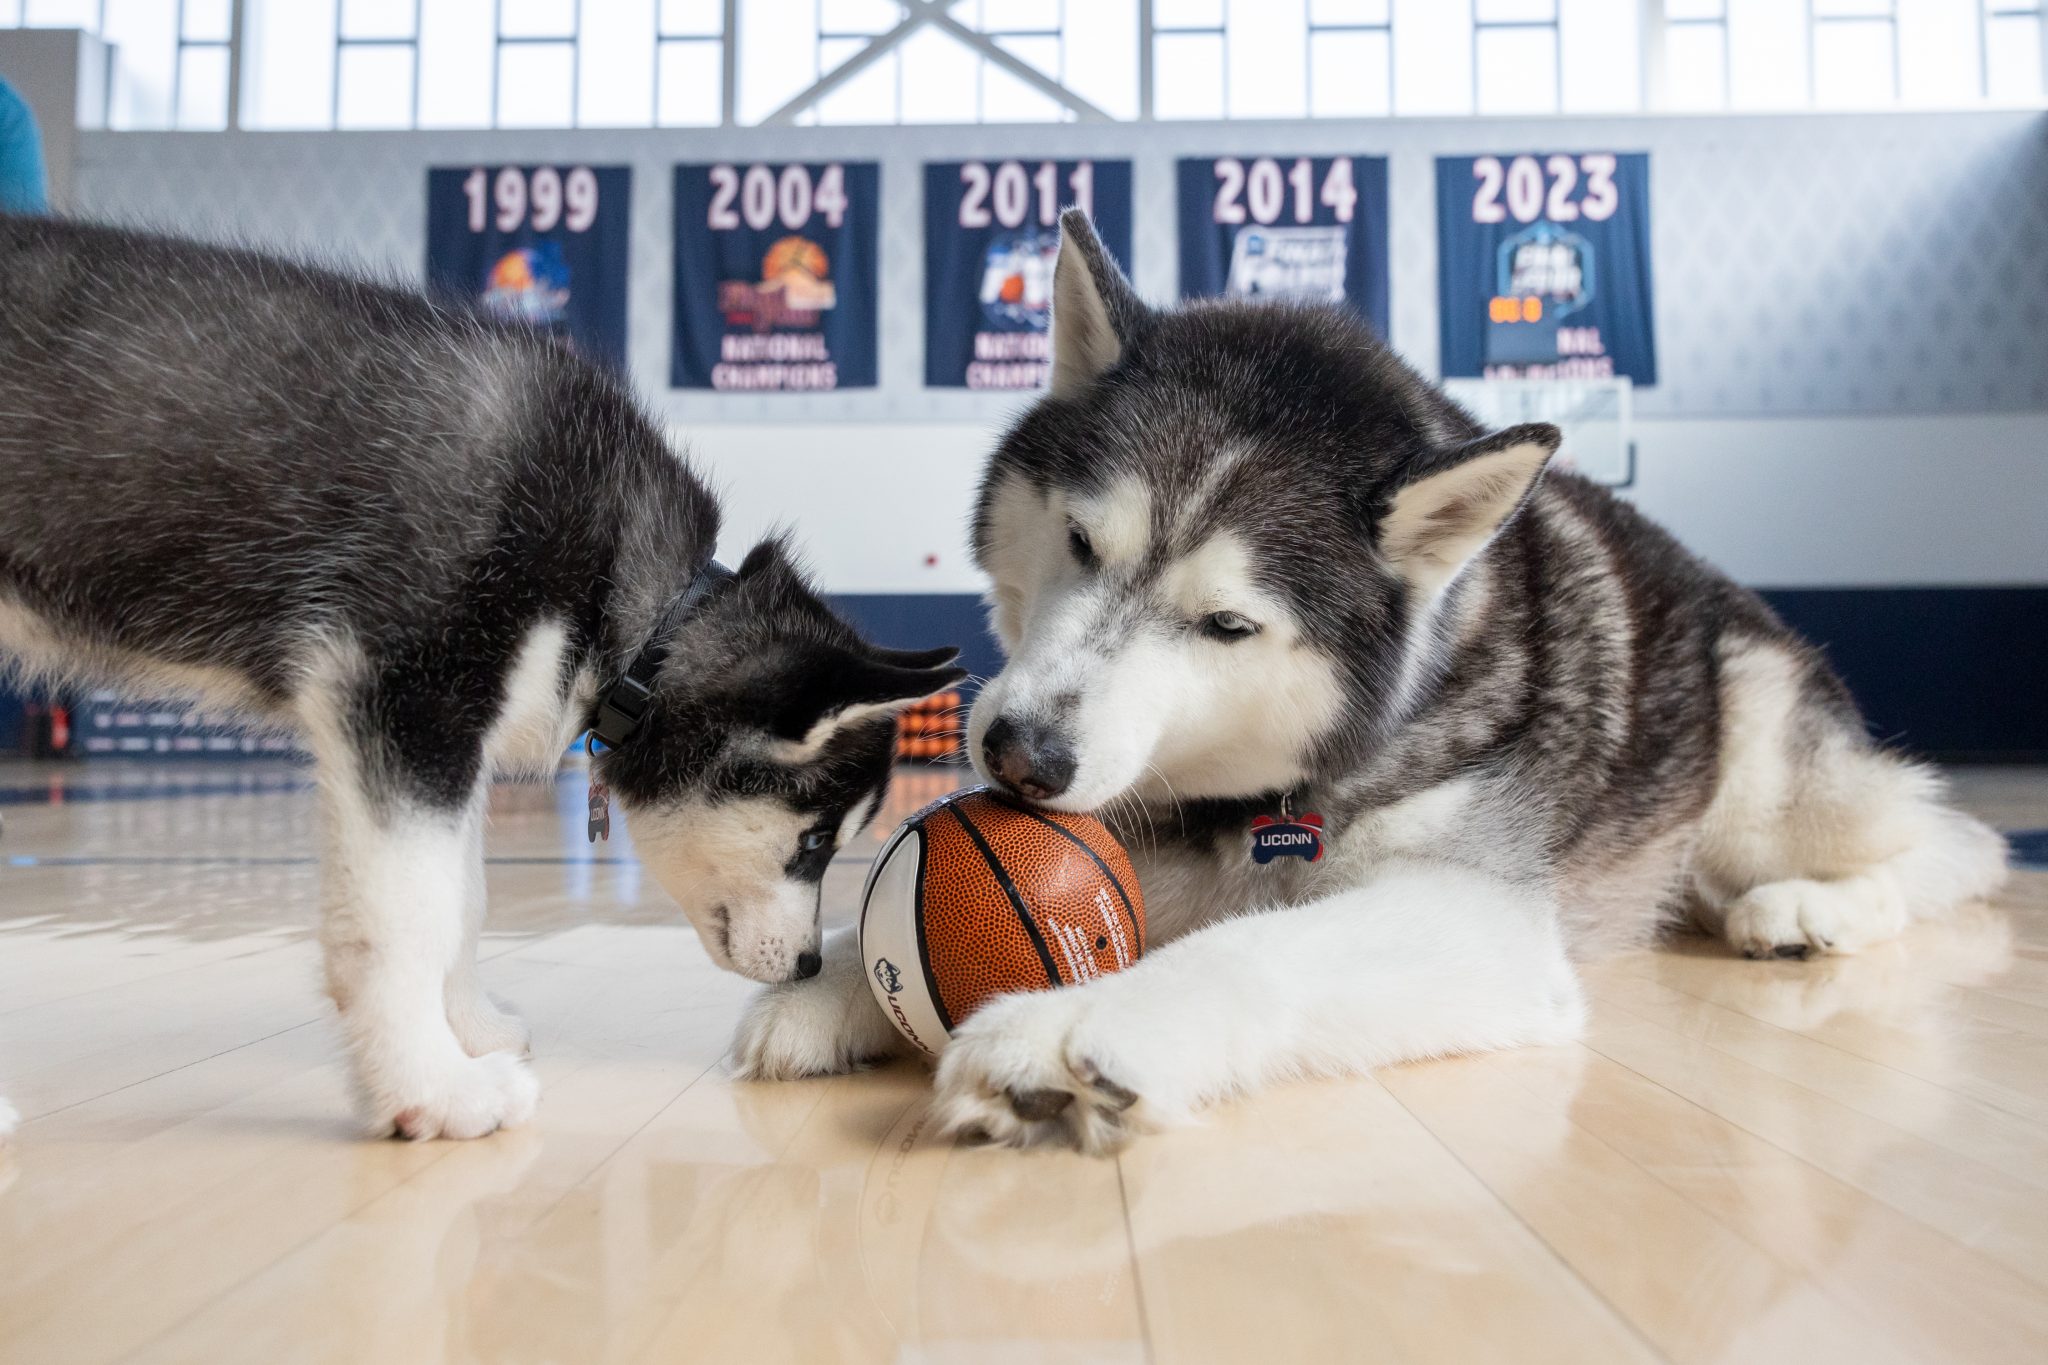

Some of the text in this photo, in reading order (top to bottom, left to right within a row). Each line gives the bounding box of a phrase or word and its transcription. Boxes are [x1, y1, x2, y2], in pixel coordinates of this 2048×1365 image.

[464, 165, 599, 233] 1999
[708, 163, 847, 231] 2004
[958, 159, 1095, 229] 2011
[1213, 156, 1358, 225] 2014
[1471, 153, 1619, 224] 2023
[711, 361, 838, 391] CHAMPIONS
[721, 333, 830, 361] NATIONAL
[1261, 832, 1312, 847] UCONN
[1064, 924, 1079, 952] CHINA
[887, 994, 936, 1055] UCONN
